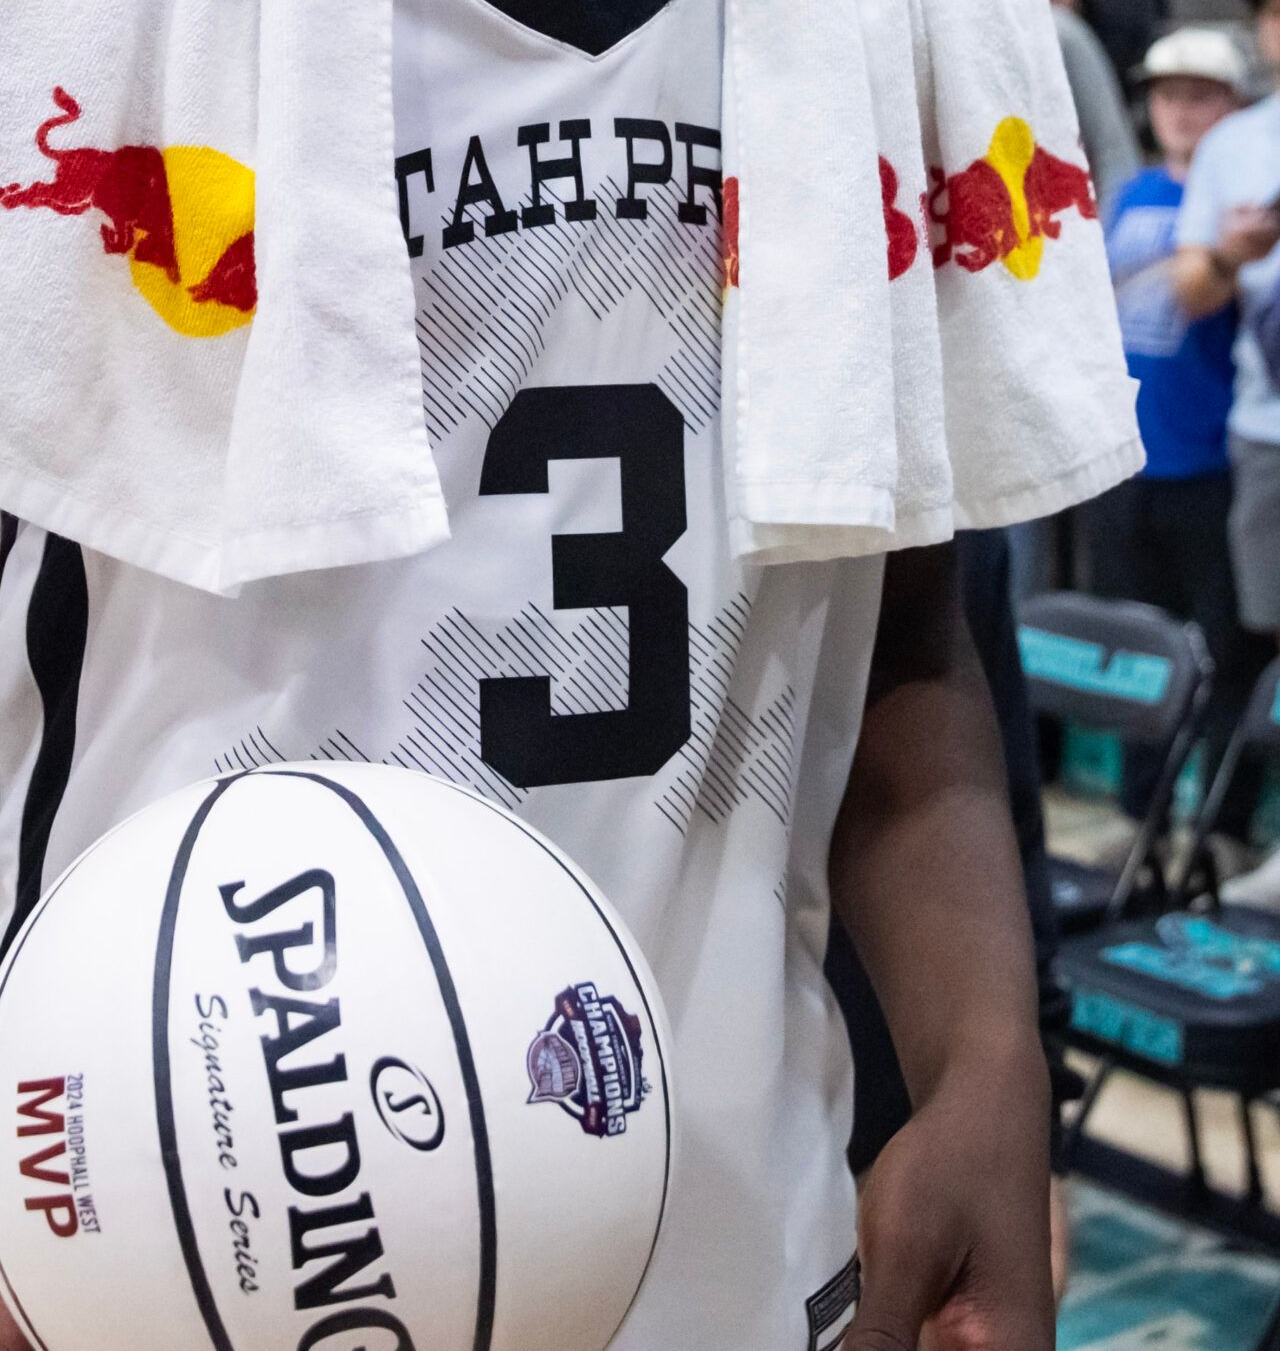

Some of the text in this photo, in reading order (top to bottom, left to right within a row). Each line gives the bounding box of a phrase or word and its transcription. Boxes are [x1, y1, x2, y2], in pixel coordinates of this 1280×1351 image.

[478, 382, 691, 789] 3
[576, 984, 626, 1136] CHAMPIONS
[17, 1075, 78, 1238] MVP
[66, 1072, 102, 1234] 2024 HOOPHALL WEST
[189, 992, 262, 1297] Signature Series
